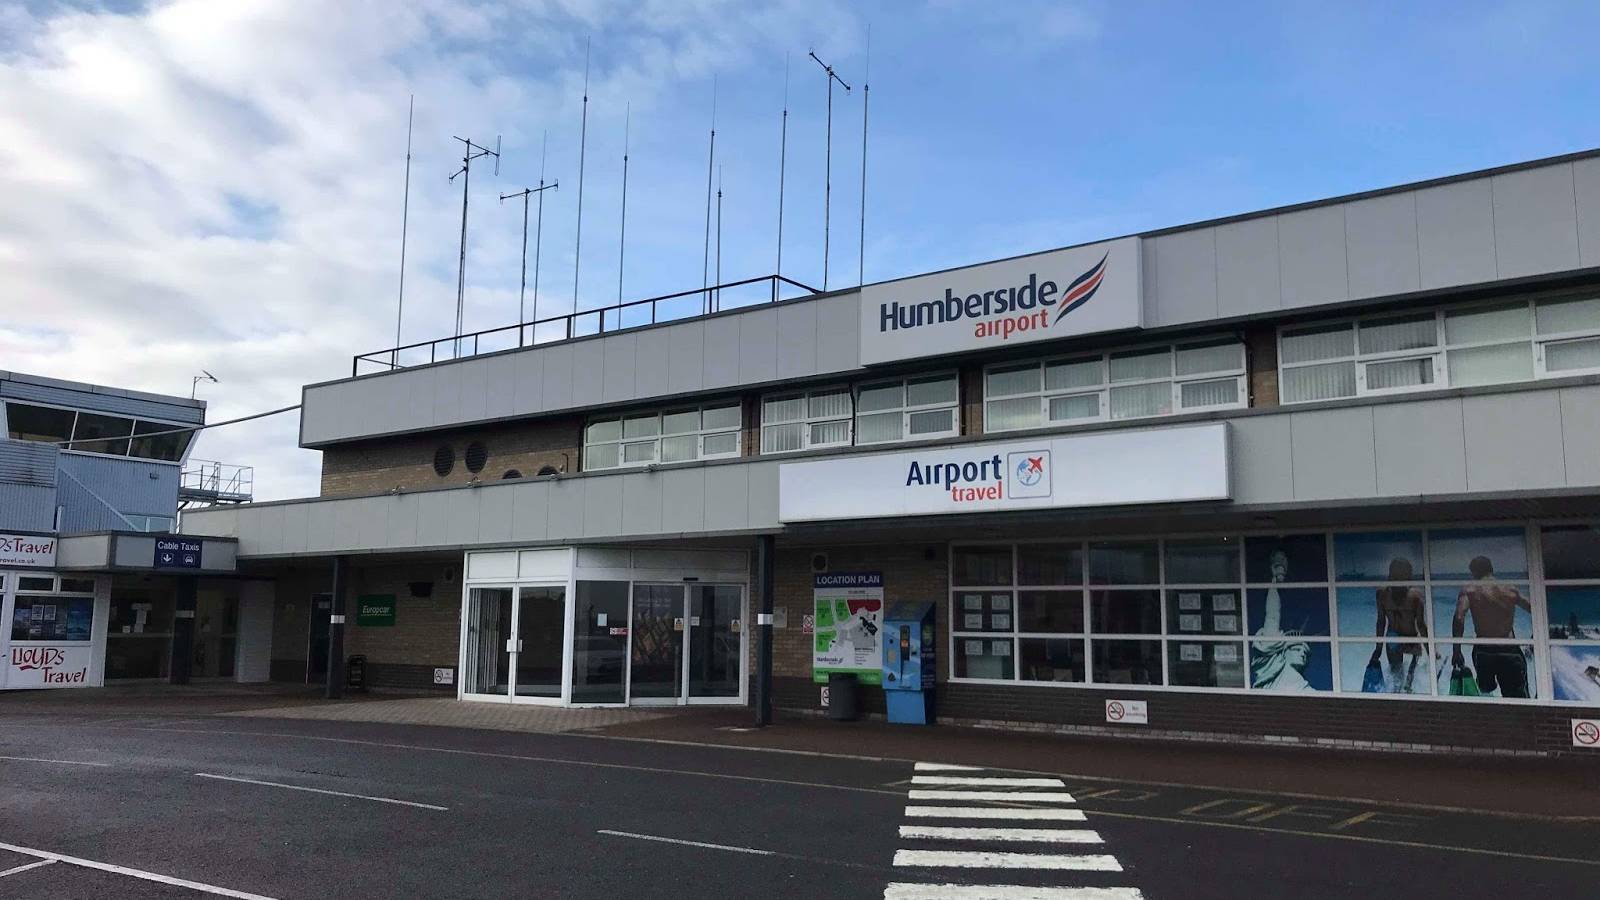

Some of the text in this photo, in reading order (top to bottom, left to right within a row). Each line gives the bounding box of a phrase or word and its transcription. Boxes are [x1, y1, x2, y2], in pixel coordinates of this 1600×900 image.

[880, 273, 1058, 332] Humberside
[974, 309, 1049, 340] airport
[906, 454, 1002, 491] Airport
[952, 480, 1003, 502] travel
[13, 538, 54, 554] Travel
[157, 540, 200, 551] Cable Taxis
[816, 575, 880, 585] LOCATION PLAN
[362, 605, 391, 615] Europcar
[41, 666, 87, 683] Travel
